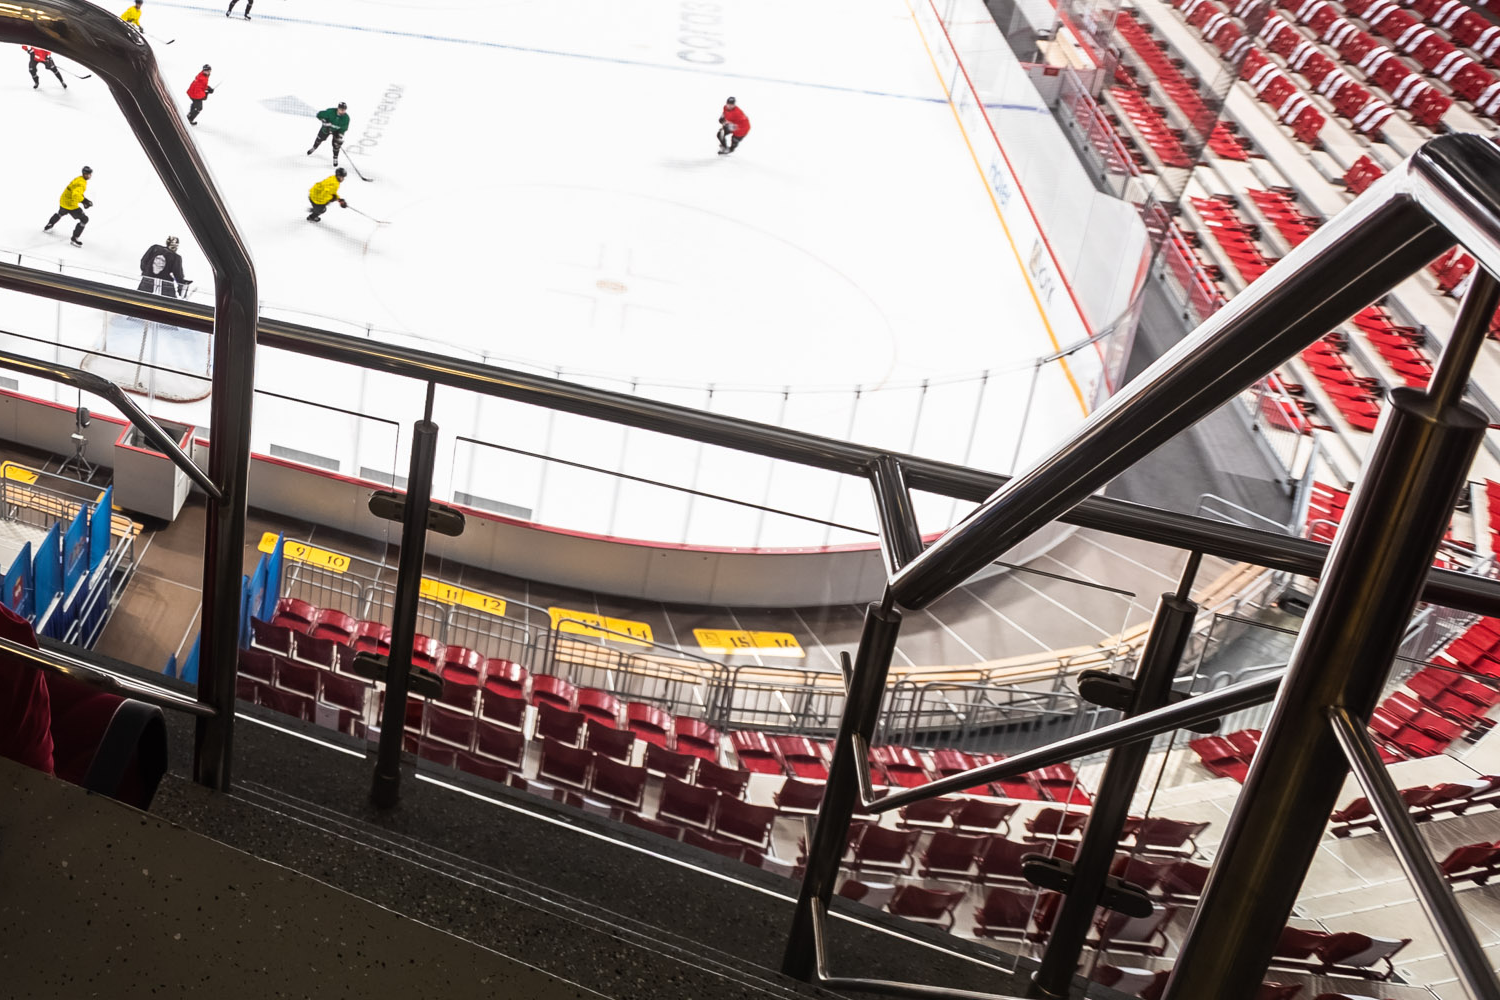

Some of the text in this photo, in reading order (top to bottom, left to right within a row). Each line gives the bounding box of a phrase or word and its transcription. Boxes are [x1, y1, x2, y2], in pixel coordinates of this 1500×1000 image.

[296, 546, 306, 556] 9
[328, 556, 345, 567] 10
[447, 590, 457, 600] 11
[483, 599, 501, 611] 12
[730, 637, 750, 648] 15
